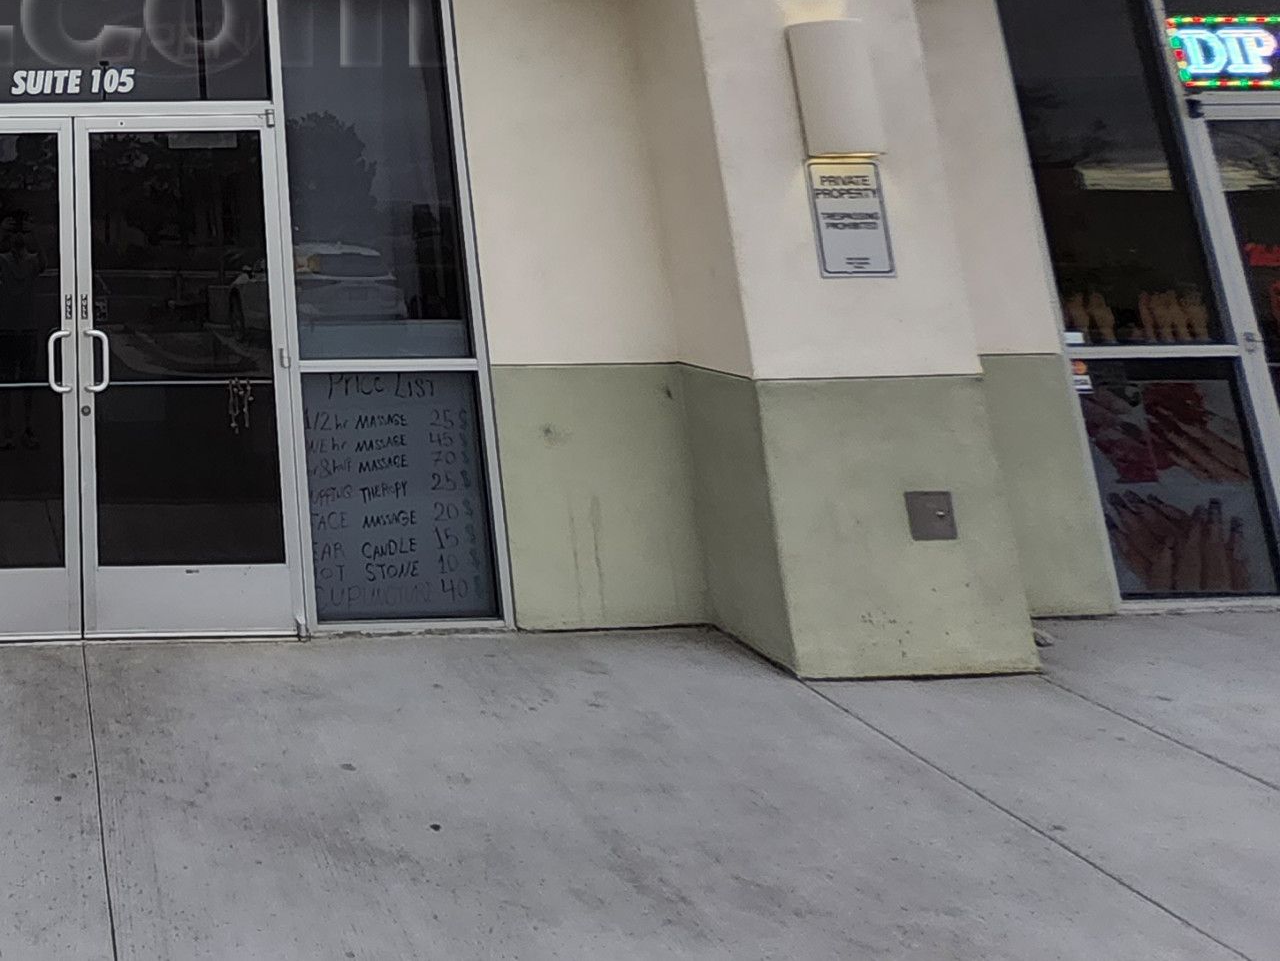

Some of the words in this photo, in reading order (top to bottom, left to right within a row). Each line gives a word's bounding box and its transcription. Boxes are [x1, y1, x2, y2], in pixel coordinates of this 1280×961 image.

[1177, 27, 1279, 74] DIP
[11, 69, 82, 95] SUITE
[91, 68, 135, 93] 105
[820, 175, 871, 186] PRIVATE
[335, 414, 348, 430] hr
[355, 413, 407, 430] MASSAGE
[430, 409, 454, 430] 25
[331, 437, 347, 451] hr
[355, 435, 407, 453] MASSAGE
[358, 455, 408, 474] MASSAGE
[362, 510, 417, 529] MASSAGE
[434, 501, 459, 521] 20
[362, 538, 417, 560] CANDLE
[435, 526, 459, 550] 15
[365, 560, 419, 582] STONE
[439, 553, 459, 574] 10
[441, 578, 468, 601] 40
